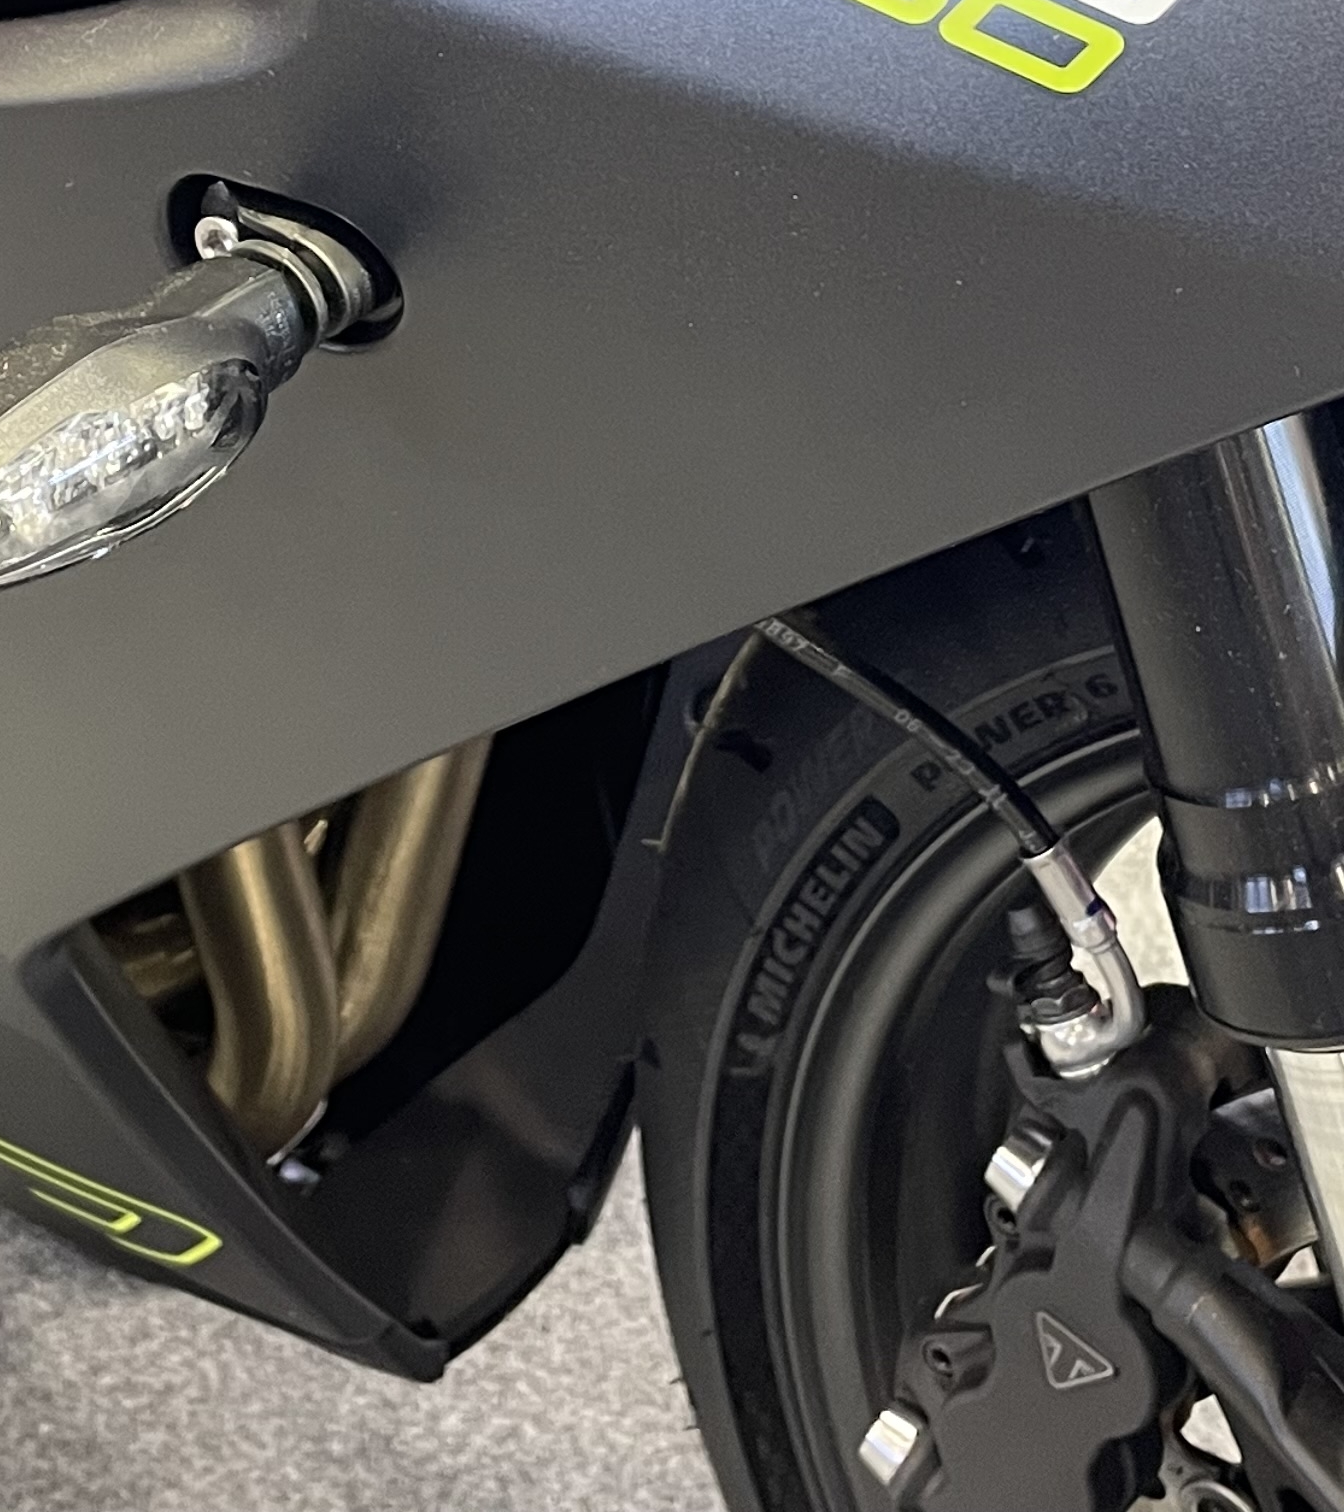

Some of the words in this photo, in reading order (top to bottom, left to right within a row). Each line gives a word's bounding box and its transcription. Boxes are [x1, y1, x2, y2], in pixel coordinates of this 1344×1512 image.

[747, 815, 885, 1028] MICHELIN
[911, 691, 1069, 793] PWER
[1085, 672, 1118, 699] 6
